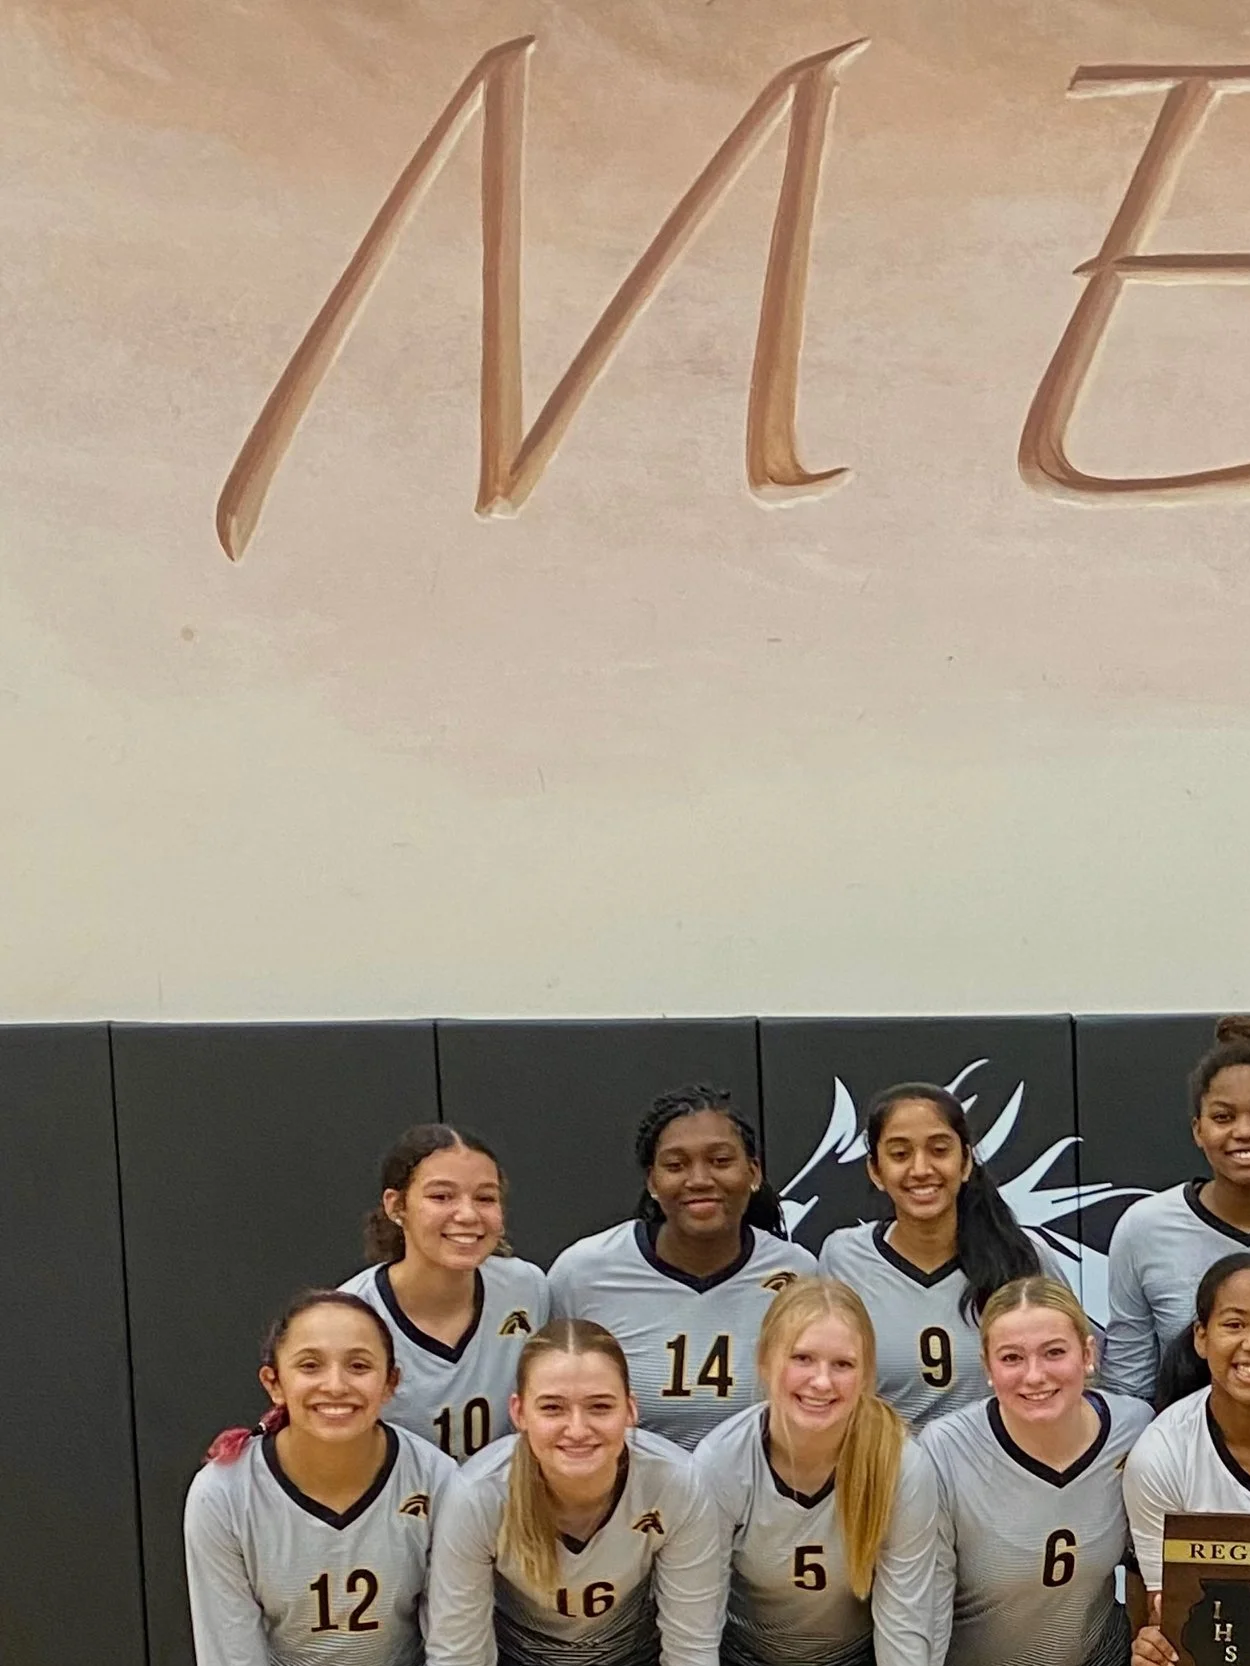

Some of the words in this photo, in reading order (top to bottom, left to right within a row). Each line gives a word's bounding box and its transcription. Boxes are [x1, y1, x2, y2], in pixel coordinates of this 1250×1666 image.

[661, 1335, 735, 1397] 14
[918, 1326, 954, 1388] 9
[431, 1396, 493, 1457] 10
[793, 1546, 828, 1591] 5
[1042, 1529, 1077, 1587] 6
[309, 1569, 381, 1633] 12
